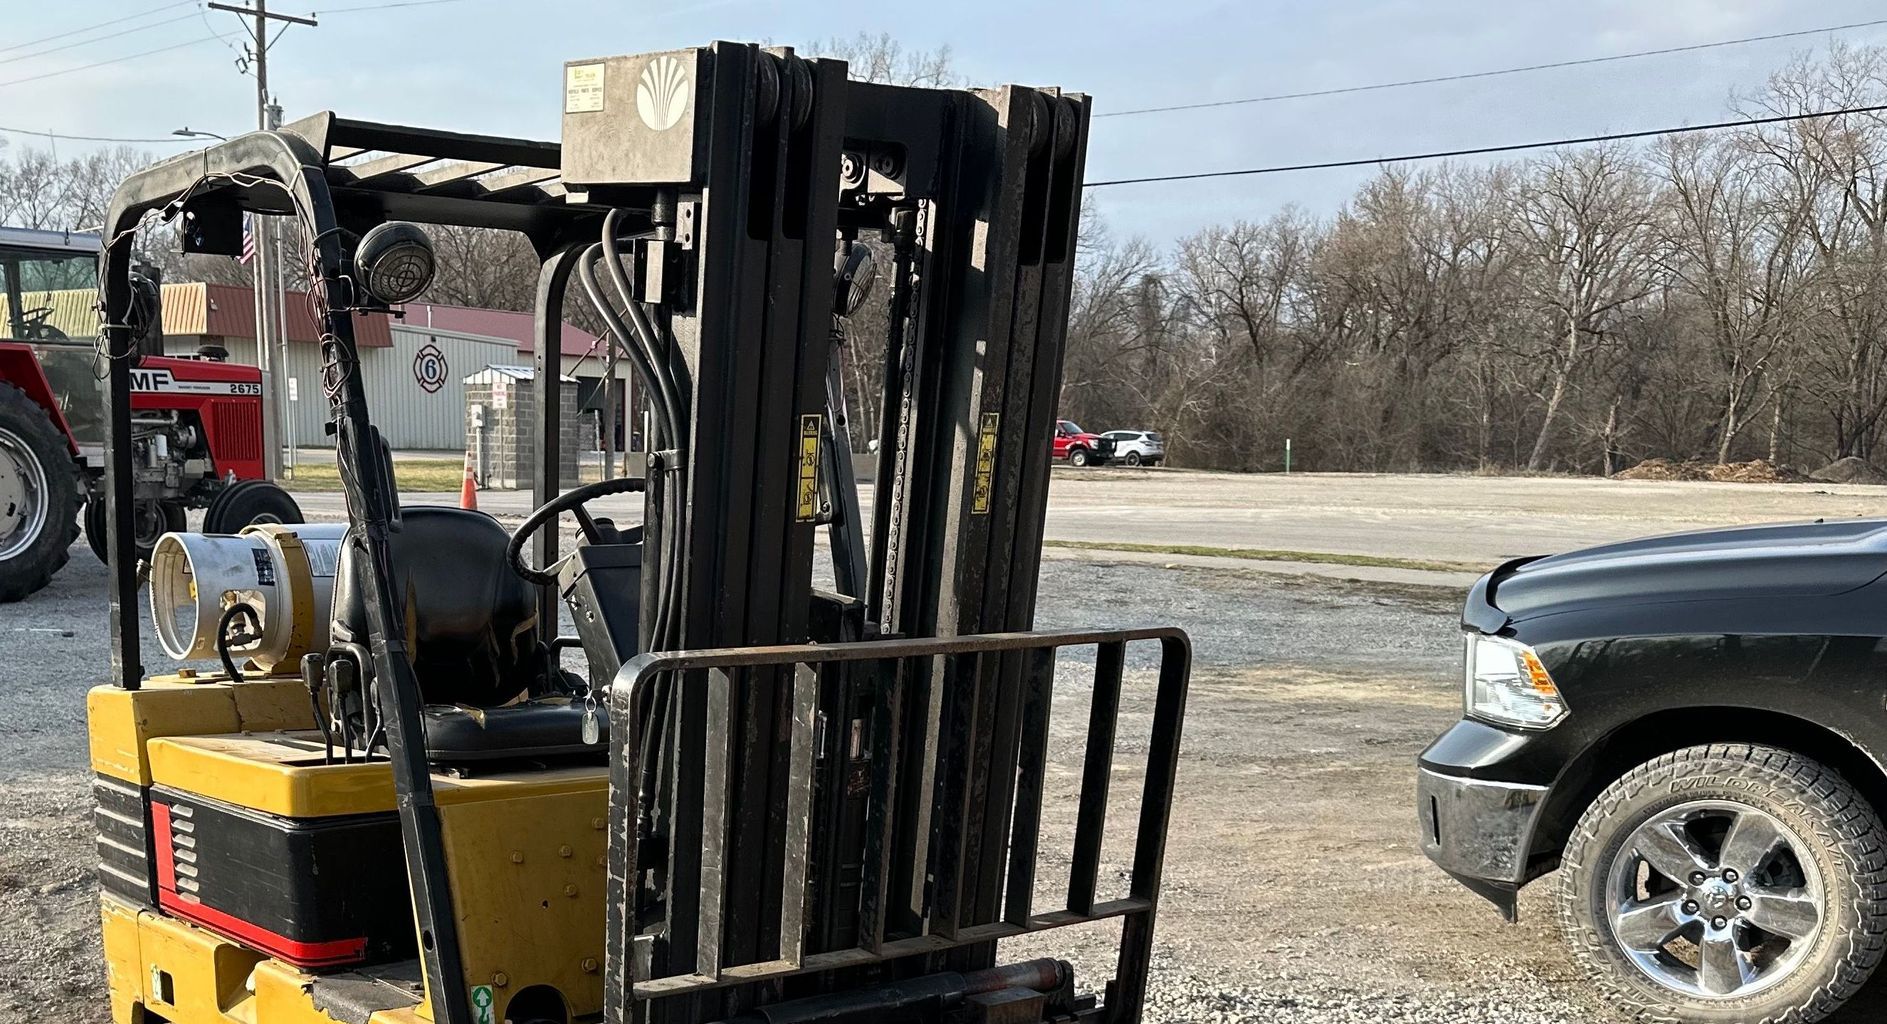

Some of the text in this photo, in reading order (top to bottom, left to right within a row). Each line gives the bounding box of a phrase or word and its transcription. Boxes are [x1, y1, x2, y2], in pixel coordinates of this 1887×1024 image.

[425, 359, 437, 379] 6
[131, 372, 169, 391] MF
[230, 383, 259, 394] 2675
[1668, 774, 1822, 829] WILDPEAK
